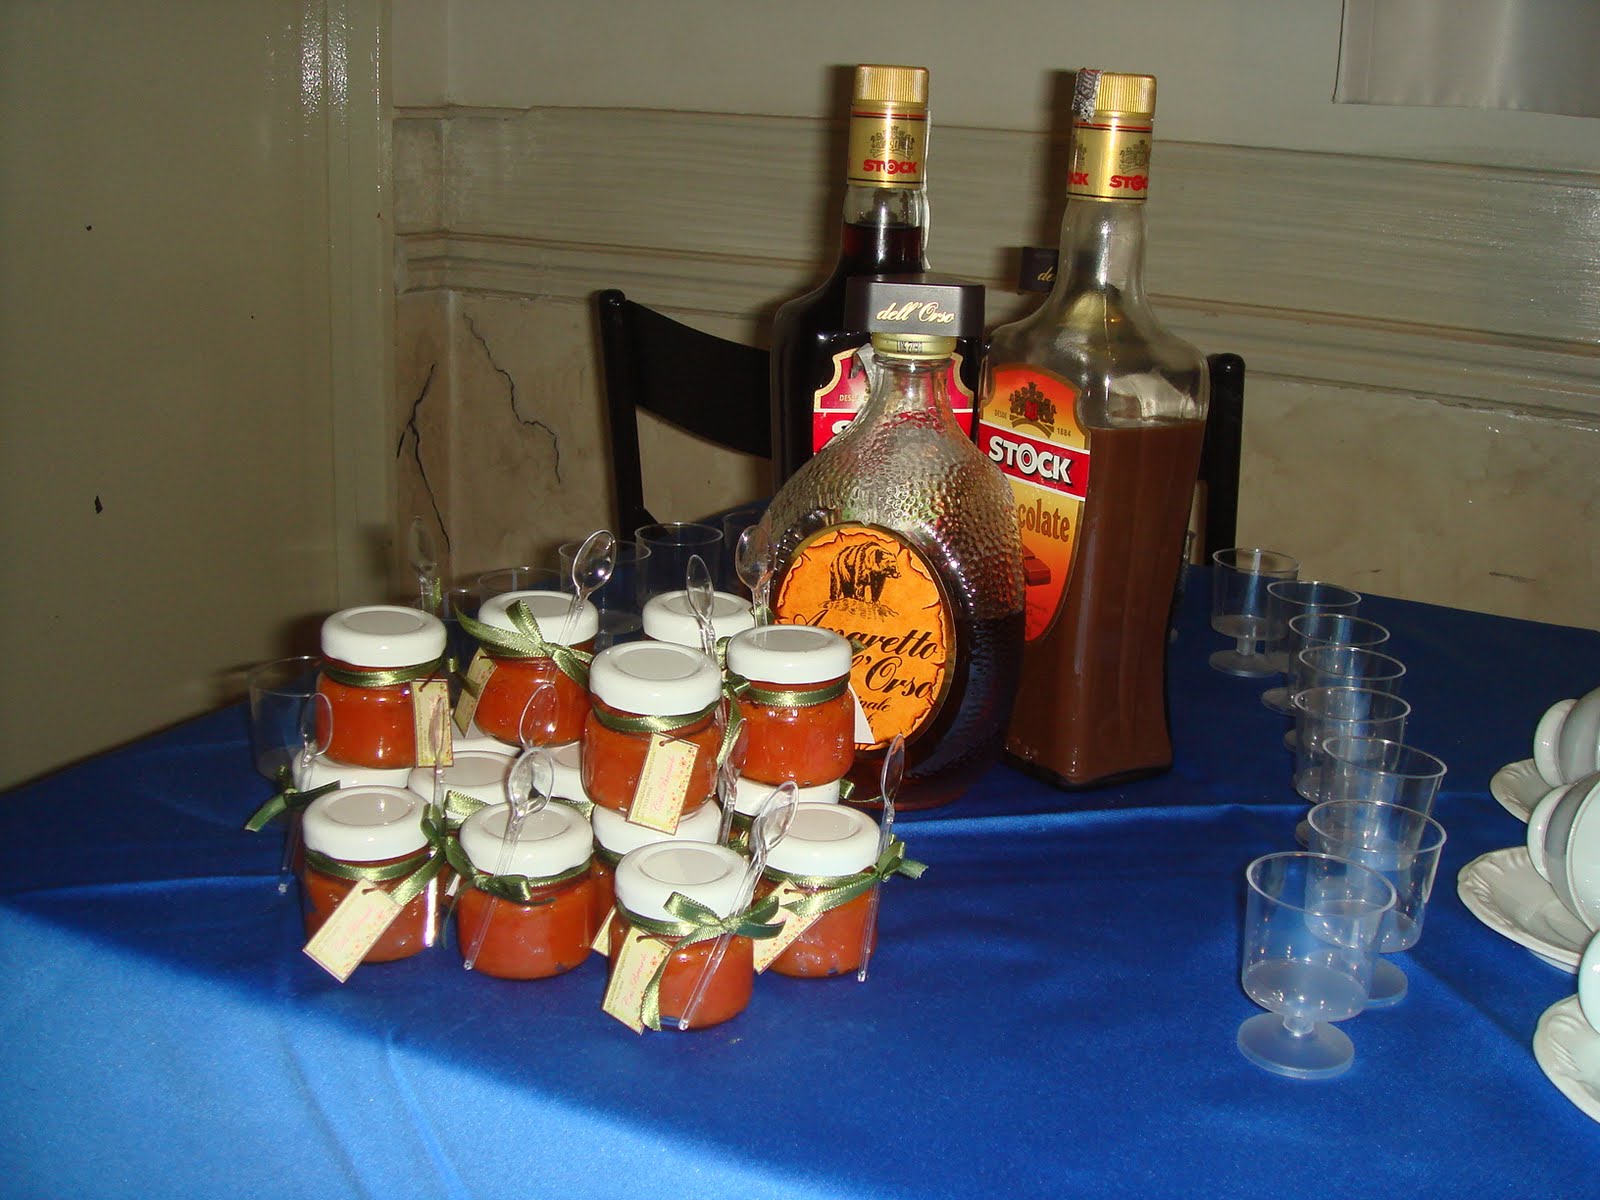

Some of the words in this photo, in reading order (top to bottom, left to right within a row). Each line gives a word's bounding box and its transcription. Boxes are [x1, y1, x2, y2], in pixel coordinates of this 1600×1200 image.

[863, 159, 917, 174] STOCK
[876, 301, 955, 324] dell'Orso
[994, 409, 1008, 420] DESDE
[1056, 427, 1072, 437] 1884
[988, 435, 1073, 485] STOCK
[1018, 498, 1070, 543] colate
